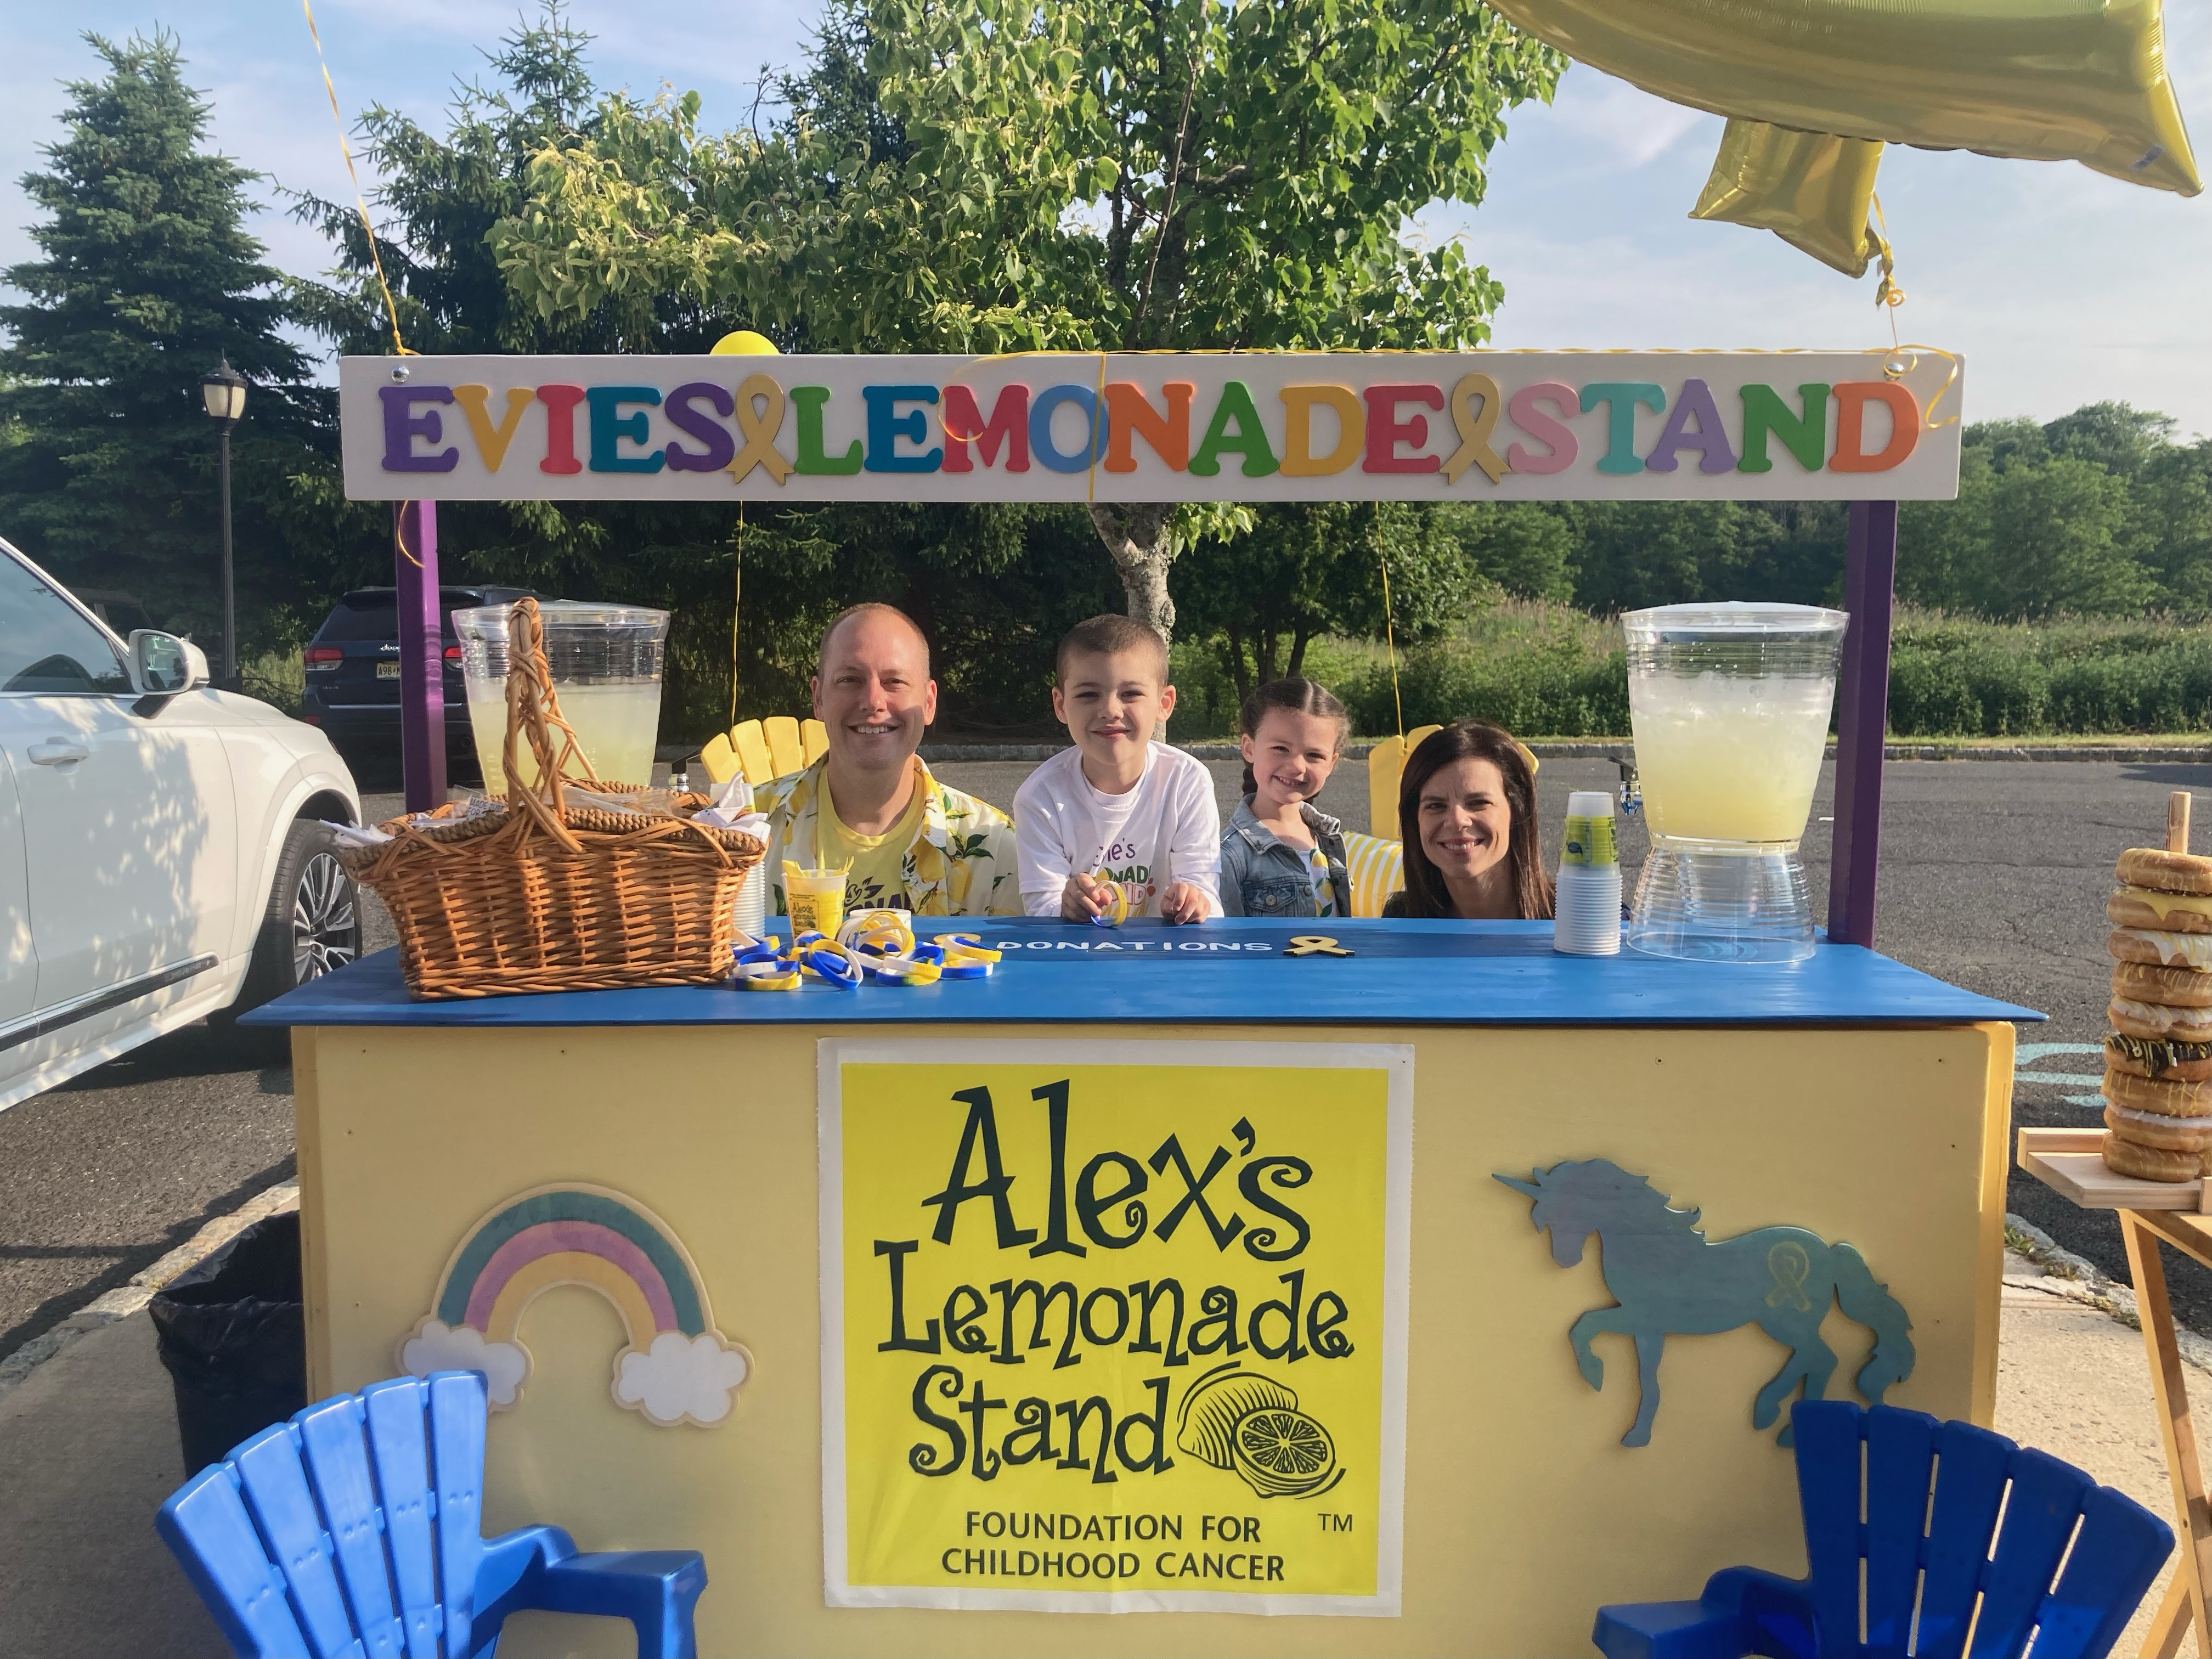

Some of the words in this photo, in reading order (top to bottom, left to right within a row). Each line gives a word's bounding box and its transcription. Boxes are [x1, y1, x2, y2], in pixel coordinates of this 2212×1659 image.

[379, 382, 735, 475] EVIES
[790, 379, 1445, 475] LEMONADE
[1508, 379, 1920, 475] STAND
[468, 807, 481, 816] FOR
[470, 798, 488, 809] MADE
[488, 803, 505, 813] JUST
[996, 941, 1273, 951] DONATIONS
[921, 1078, 1313, 1262] Alex's
[874, 1239, 1355, 1369] Lemonade
[909, 1364, 1174, 1485] Stand
[966, 1511, 1183, 1541] FOUNDATION
[1201, 1515, 1261, 1543] FOR
[1317, 1513, 1354, 1533] TM
[941, 1547, 1141, 1579] CHILDHOOD
[1155, 1552, 1285, 1582] CANCER
